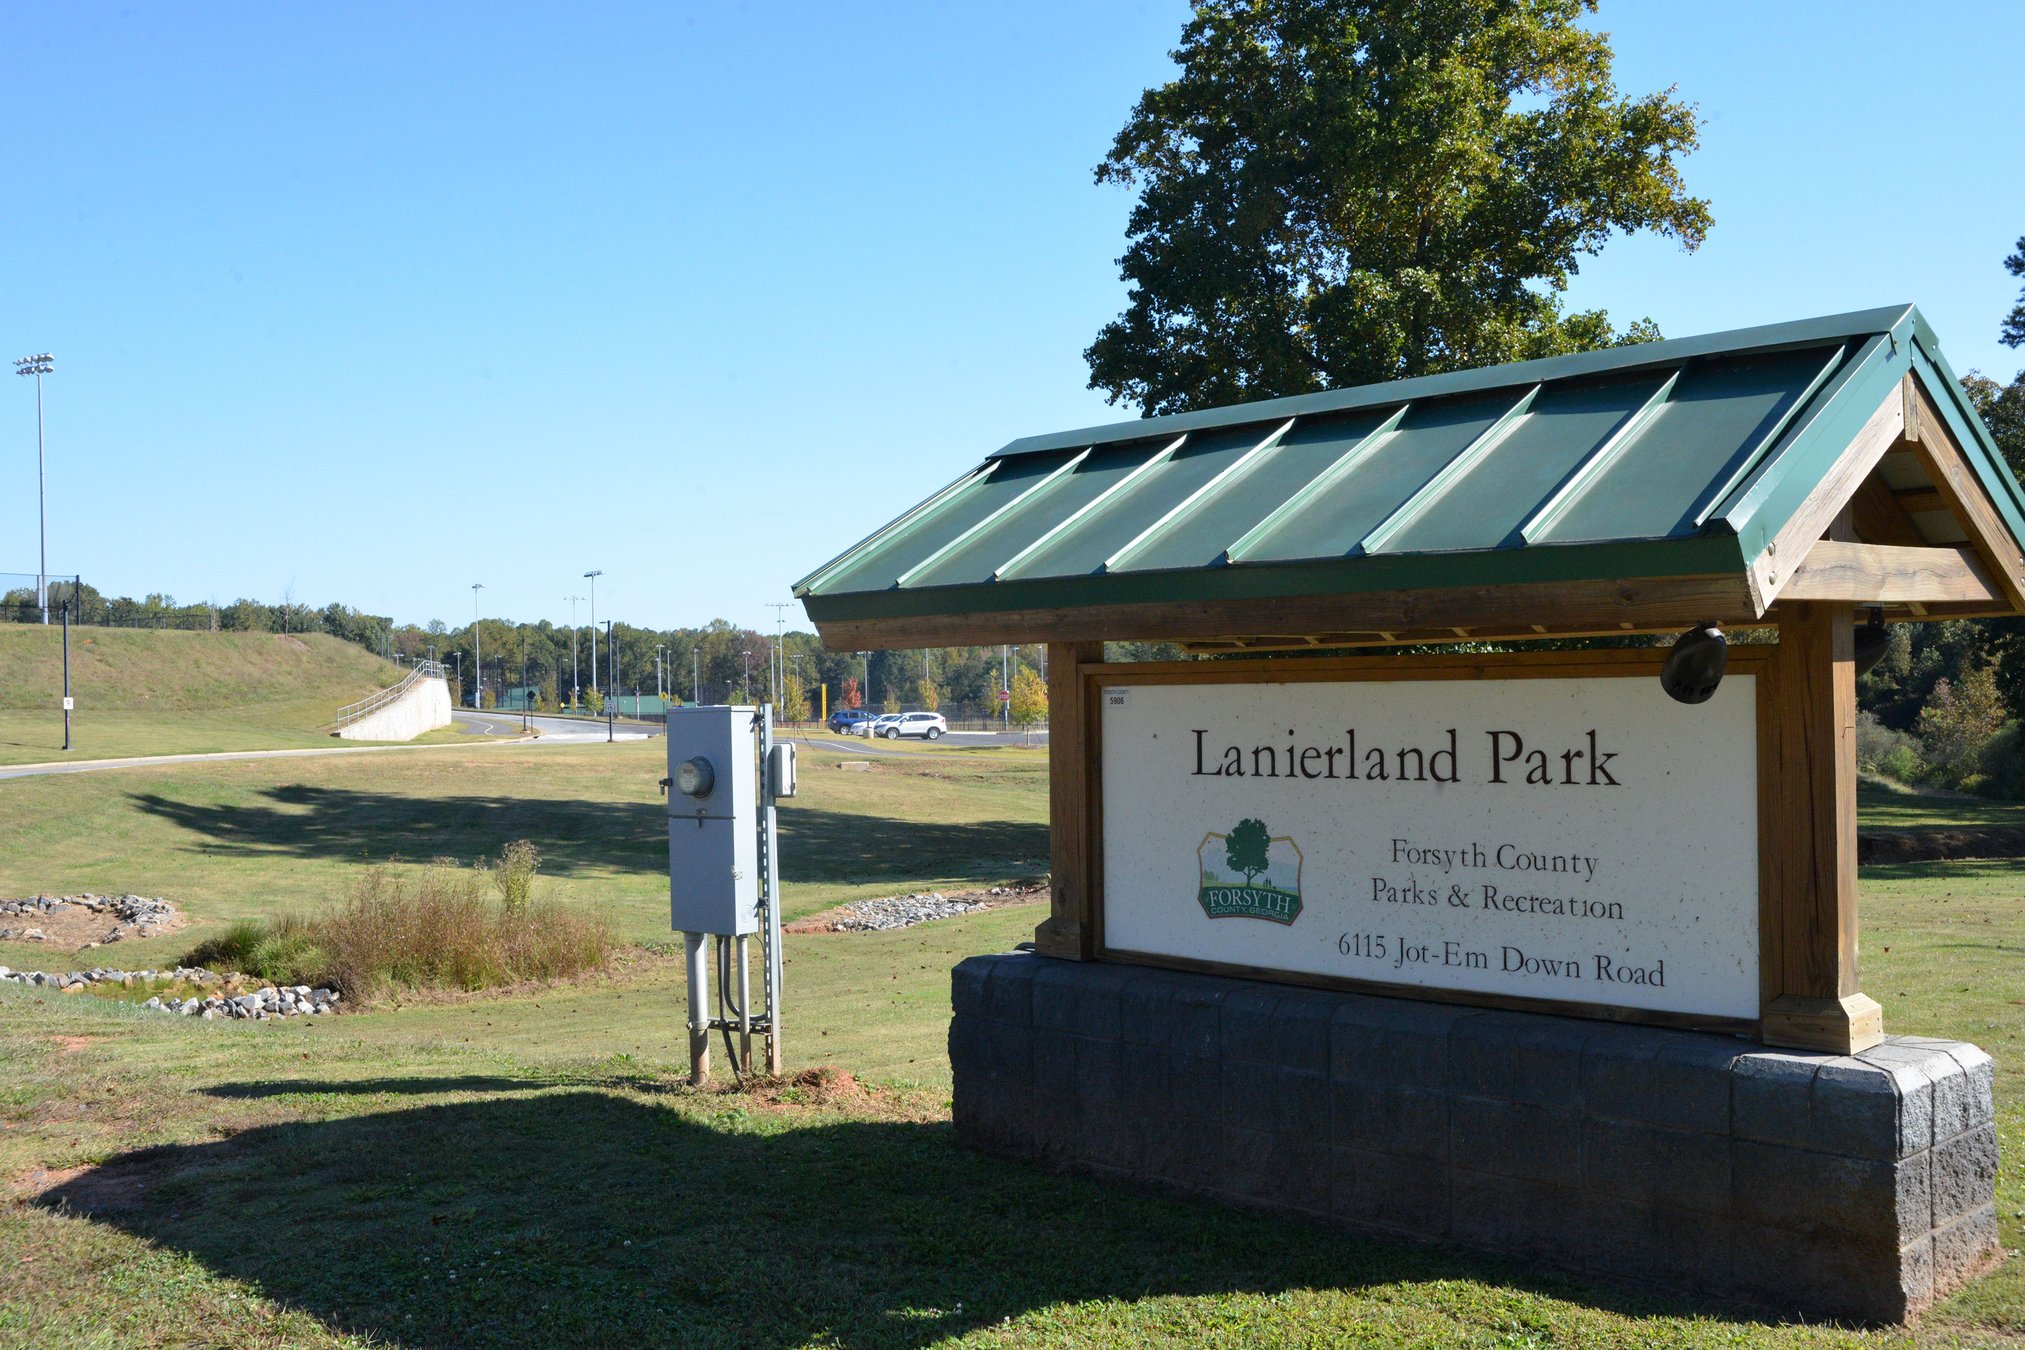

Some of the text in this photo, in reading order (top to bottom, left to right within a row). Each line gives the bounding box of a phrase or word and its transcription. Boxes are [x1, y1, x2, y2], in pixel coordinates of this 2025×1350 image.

[1109, 696, 1125, 705] 5906
[1191, 728, 1622, 786] Lanierland Park
[1391, 838, 1600, 883] Forsyth County
[1209, 888, 1292, 914] FORSYTH
[1249, 906, 1290, 920] GEORGIA
[1371, 877, 1625, 920] Parks & Recreation
[1338, 932, 1667, 988] 6115 Jot-Em Down Road
